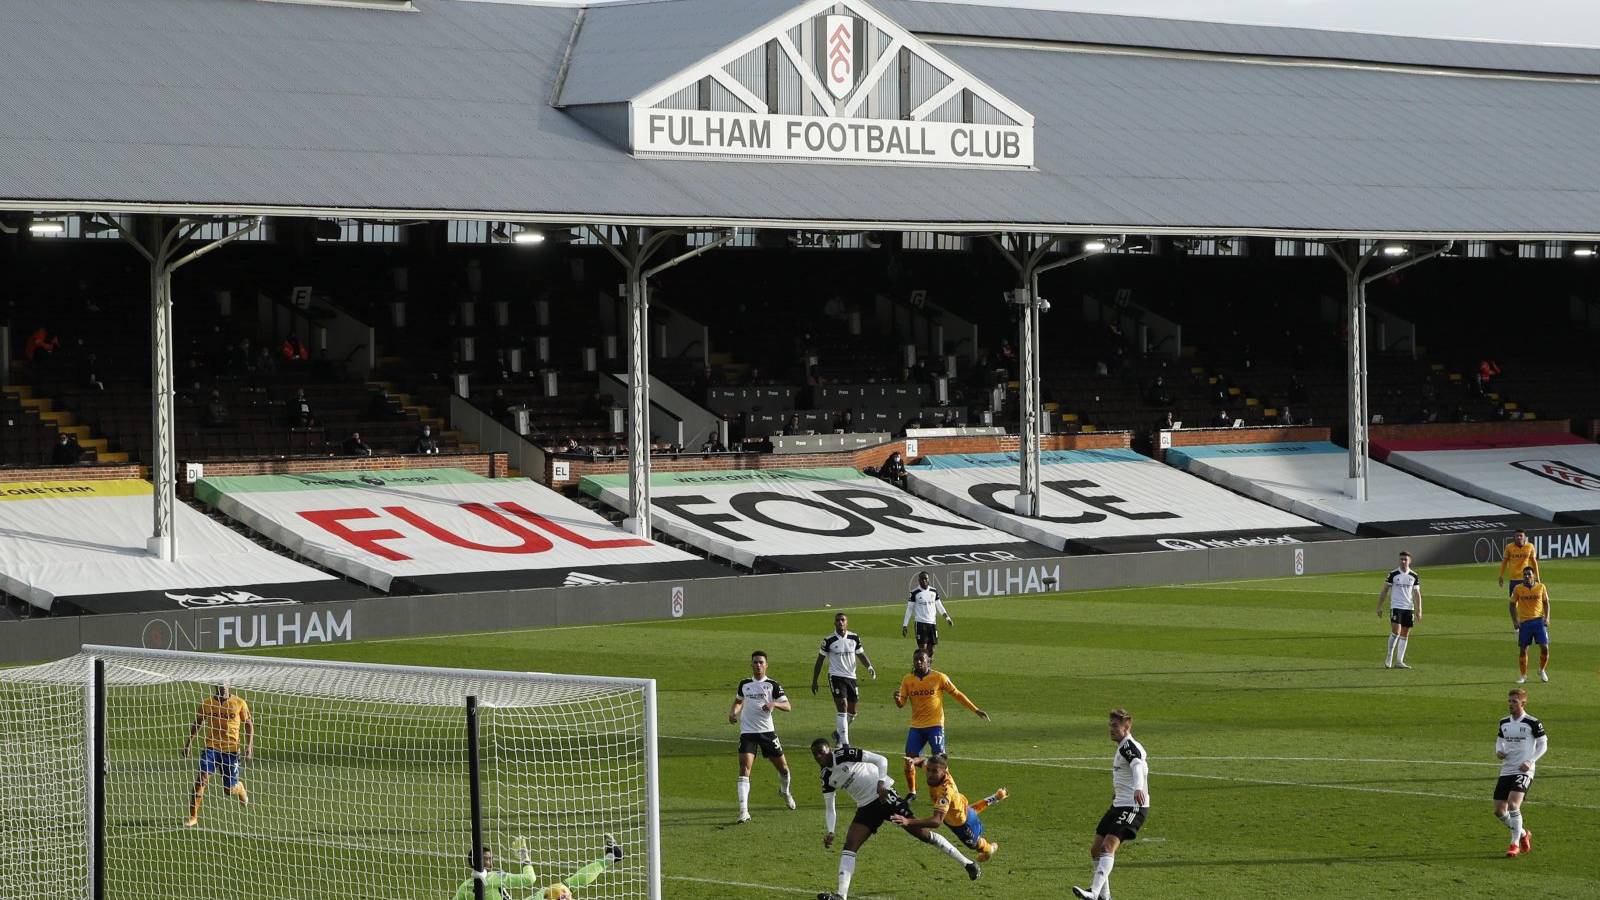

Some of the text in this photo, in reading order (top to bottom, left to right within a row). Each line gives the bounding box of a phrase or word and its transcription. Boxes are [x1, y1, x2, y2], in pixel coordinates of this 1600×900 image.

[649, 115, 1020, 159] FULHAM FOOTBALL CLUB
[907, 443, 916, 453] FL
[555, 466, 567, 476] EL
[7, 487, 44, 496] ONE
[44, 486, 97, 495] TEAM
[296, 501, 652, 561] FUL
[963, 565, 1060, 597] FULHAM
[142, 609, 352, 650] ONE FULHAM
[934, 735, 943, 745] 17
[1118, 811, 1128, 820] 5
